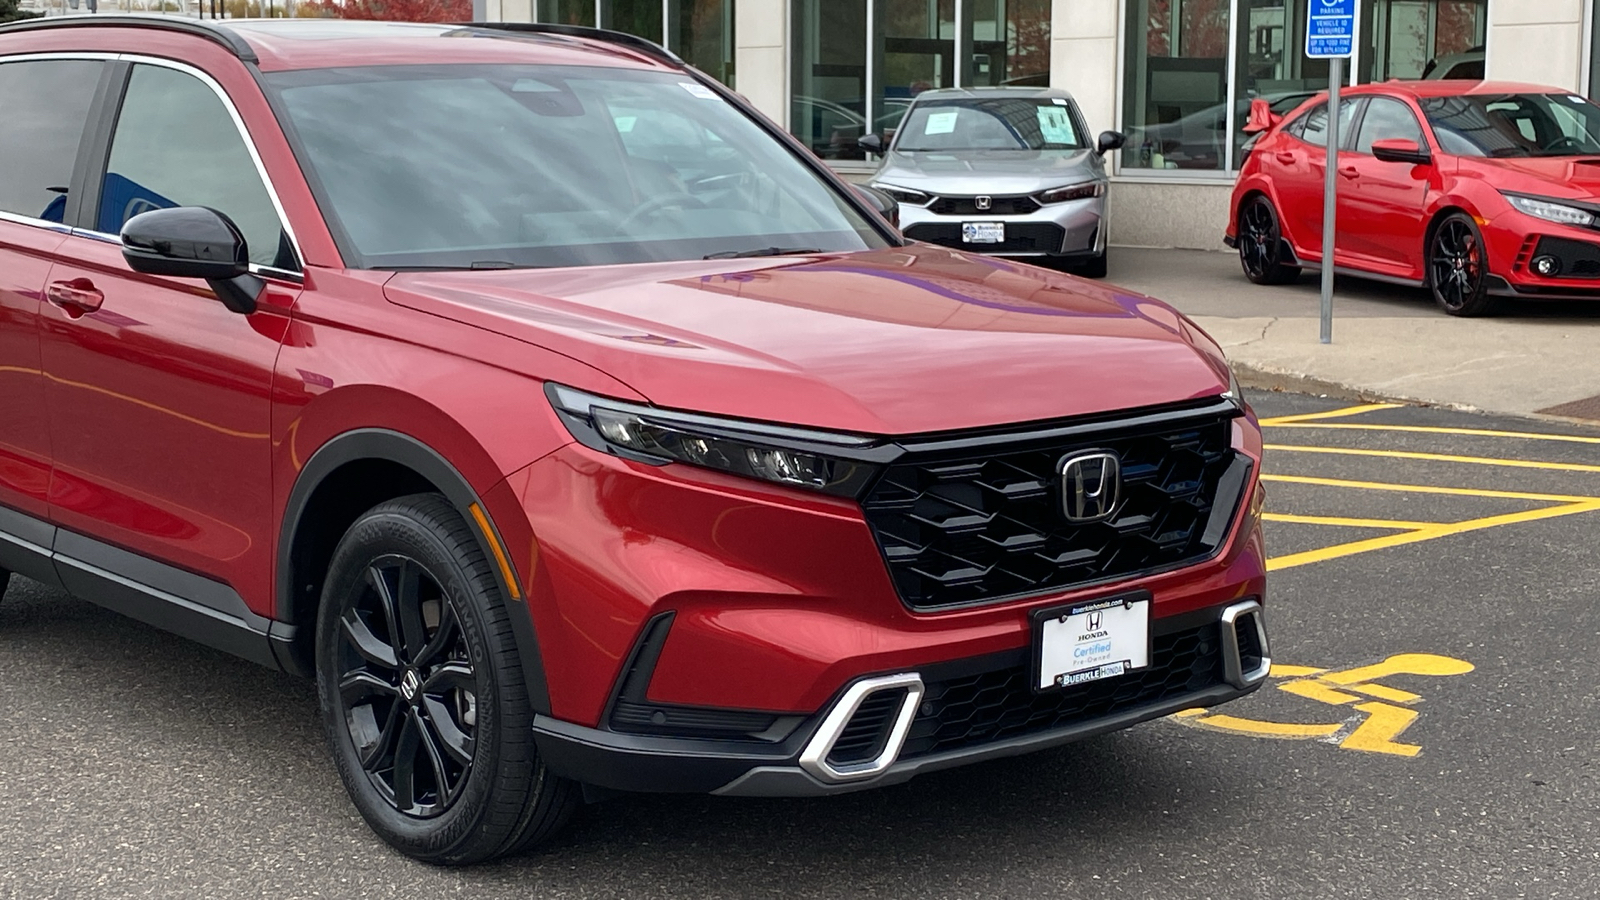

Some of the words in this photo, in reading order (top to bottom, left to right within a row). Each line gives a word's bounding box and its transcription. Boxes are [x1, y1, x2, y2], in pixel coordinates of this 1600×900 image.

[978, 230, 1003, 238] HONDA
[1072, 600, 1123, 614] buerklehonda.com
[1078, 630, 1108, 641] HONDA
[1074, 641, 1111, 658] Certified
[1073, 653, 1111, 666] Pre-Owned
[1063, 670, 1100, 685] BUERKLE
